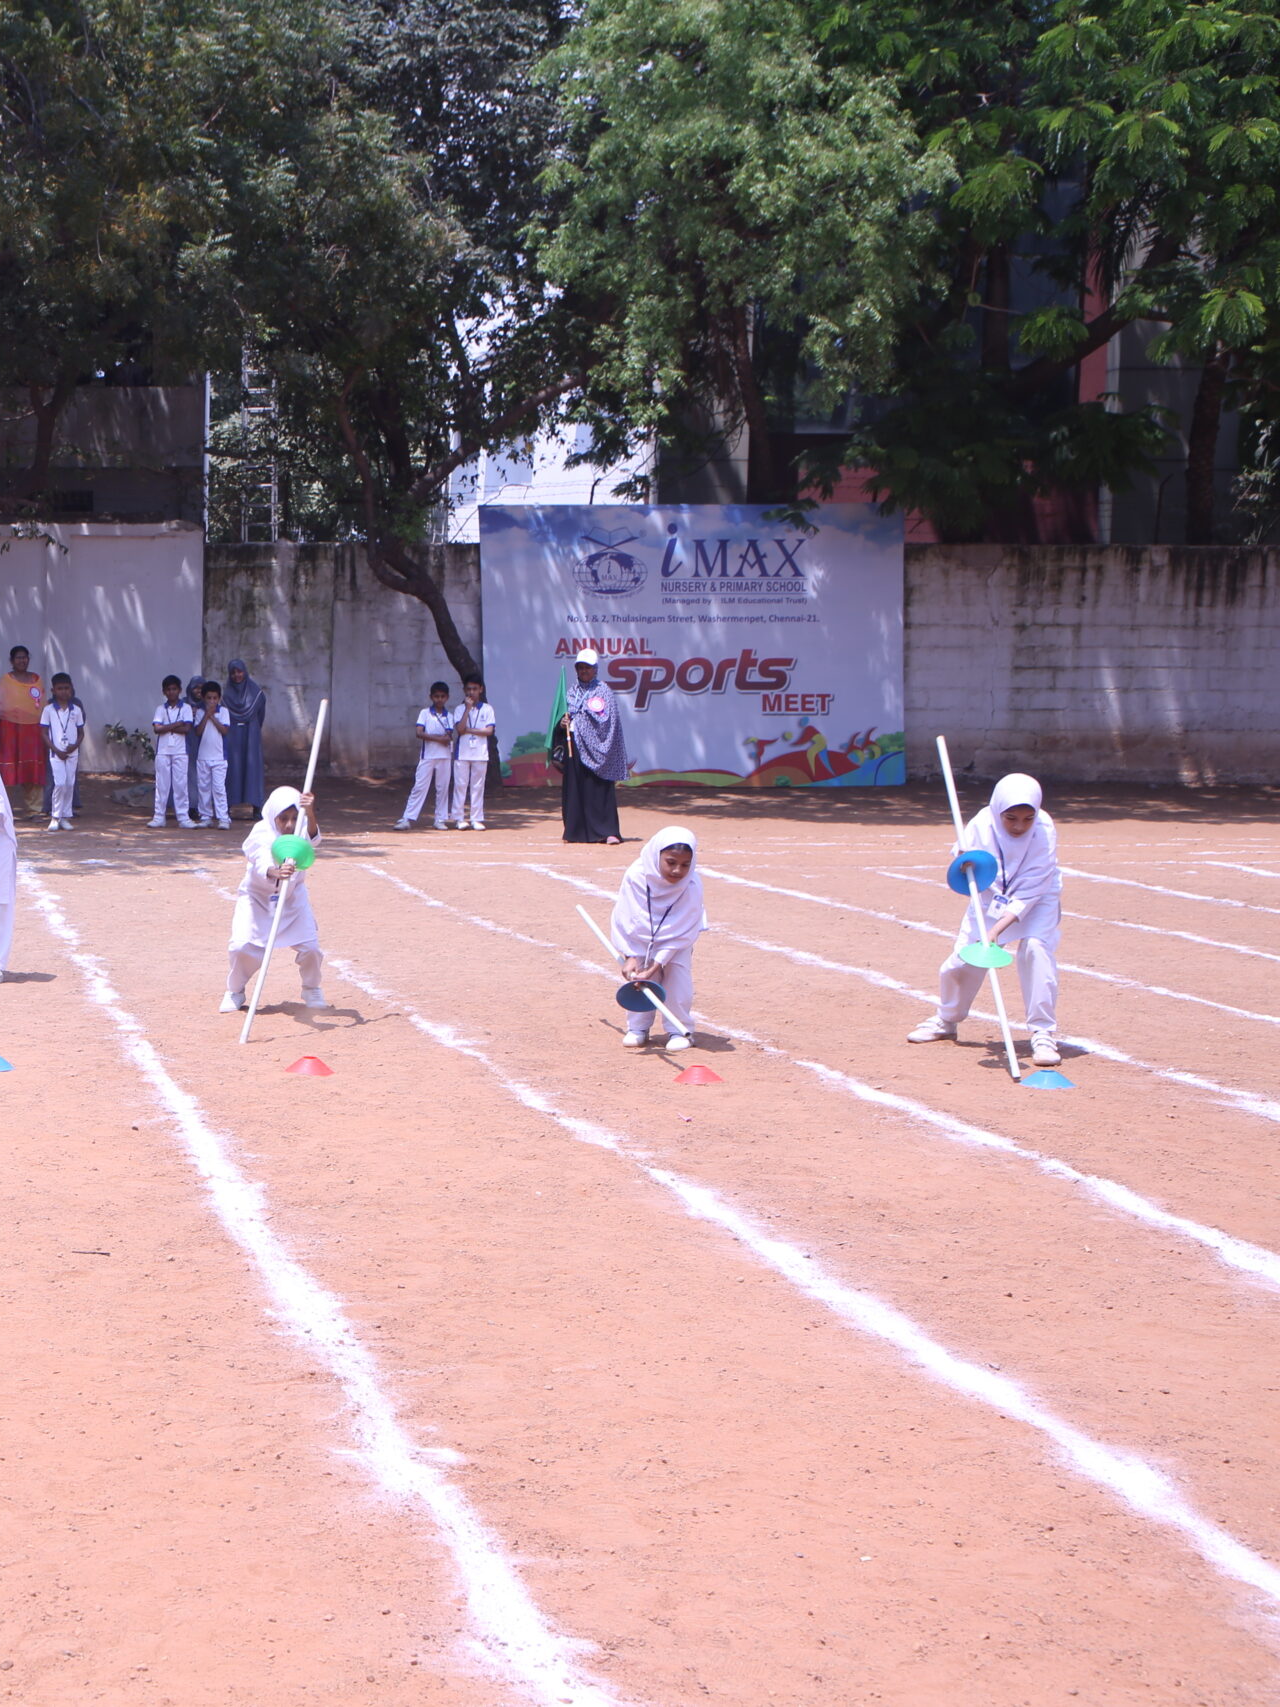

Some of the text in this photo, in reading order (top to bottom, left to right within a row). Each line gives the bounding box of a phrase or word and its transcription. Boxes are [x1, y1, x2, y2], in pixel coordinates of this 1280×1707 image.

[661, 581, 807, 592] NURSERY & PRIMARY SCHOOL
[662, 597, 701, 606] (Managed
[702, 597, 712, 606] by
[786, 597, 808, 606] Trust)
[591, 615, 599, 623] &
[601, 615, 609, 624] 2,
[611, 614, 666, 624] Thulasingam
[667, 615, 696, 624] Street,
[698, 614, 767, 624] Washermenpet,
[555, 637, 654, 657] ANNUAL
[761, 693, 833, 713] MEET
